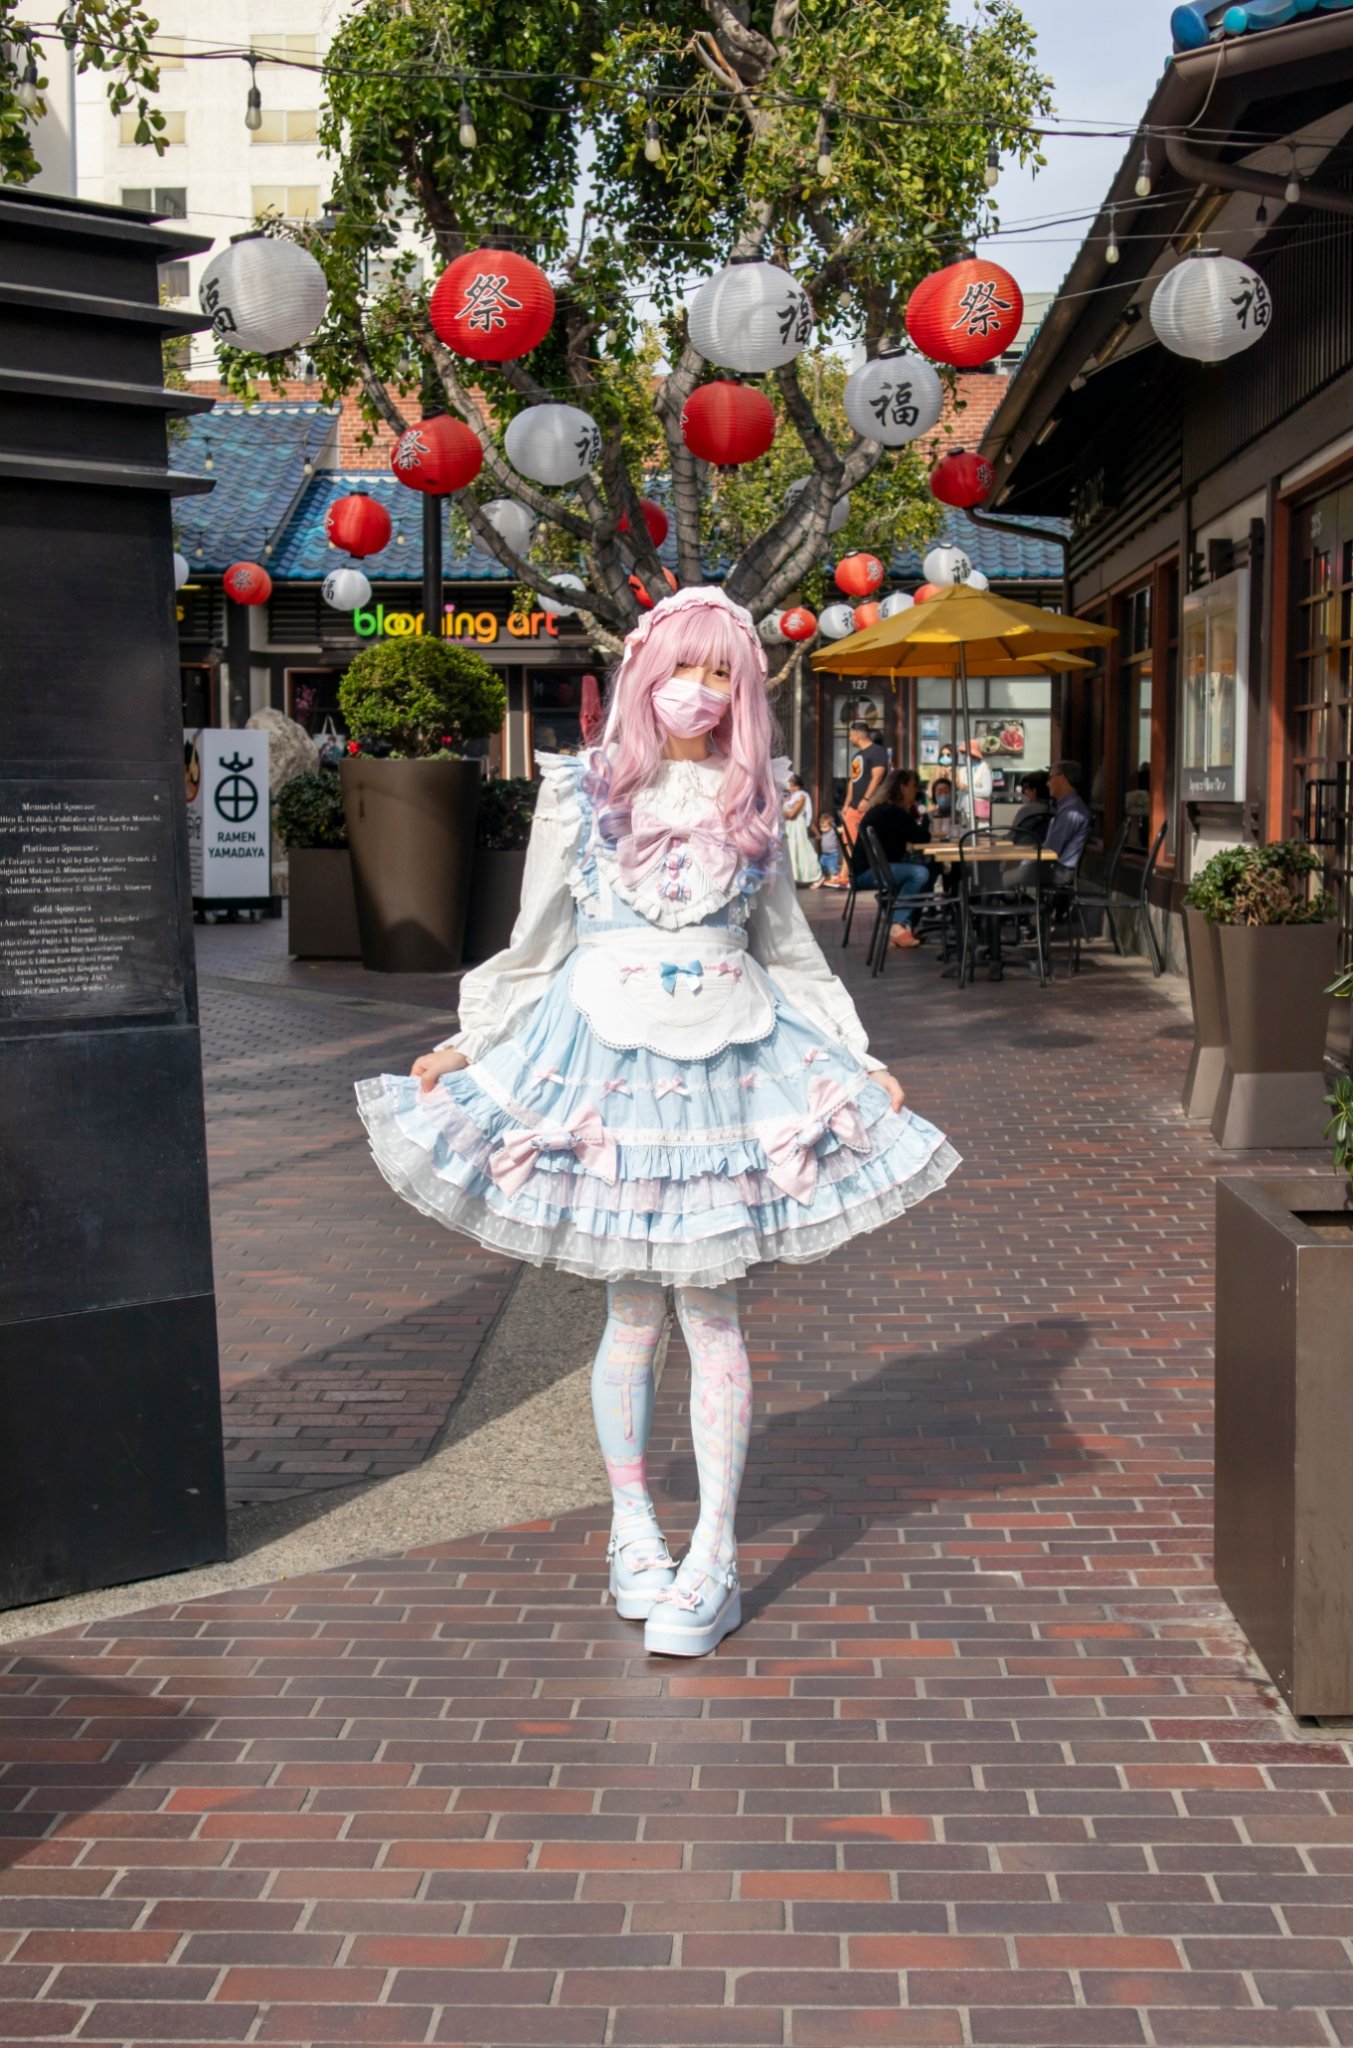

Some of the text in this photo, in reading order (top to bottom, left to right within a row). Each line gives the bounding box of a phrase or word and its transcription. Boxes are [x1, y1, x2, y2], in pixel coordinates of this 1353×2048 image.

[454, 273, 522, 333] 祭
[952, 280, 1012, 336] 祭
[1230, 276, 1271, 330] 福
[775, 290, 813, 346] 福
[869, 381, 920, 427] 福
[392, 430, 430, 470] 祭
[574, 426, 602, 467] 福
[951, 558, 971, 584] 福
[507, 613, 557, 637] art
[852, 680, 868, 690] 127
[22, 802, 96, 812] Memorial Sponsor
[55, 815, 86, 823] Publisher
[88, 815, 96, 823] of
[97, 815, 108, 823] the
[9, 825, 17, 833] of
[48, 825, 57, 834] by
[58, 825, 72, 833] The
[217, 832, 256, 843] RAMEN
[22, 843, 98, 854] Platinum Sponsors
[208, 848, 265, 858] YAMADAYA
[74, 857, 83, 865] by
[10, 875, 113, 885] Little Tokyo Historical Society
[33, 904, 92, 914] Gold Sponsors
[4, 918, 38, 927] American
[113, 914, 139, 924] Angeles
[29, 927, 58, 936] Matthew
[74, 926, 97, 935] Family
[2, 948, 35, 957] Japanese
[37, 946, 69, 955] American
[86, 945, 123, 953] Association
[97, 954, 120, 963] Family
[35, 976, 68, 985] Fernando
[69, 975, 89, 984] Valley
